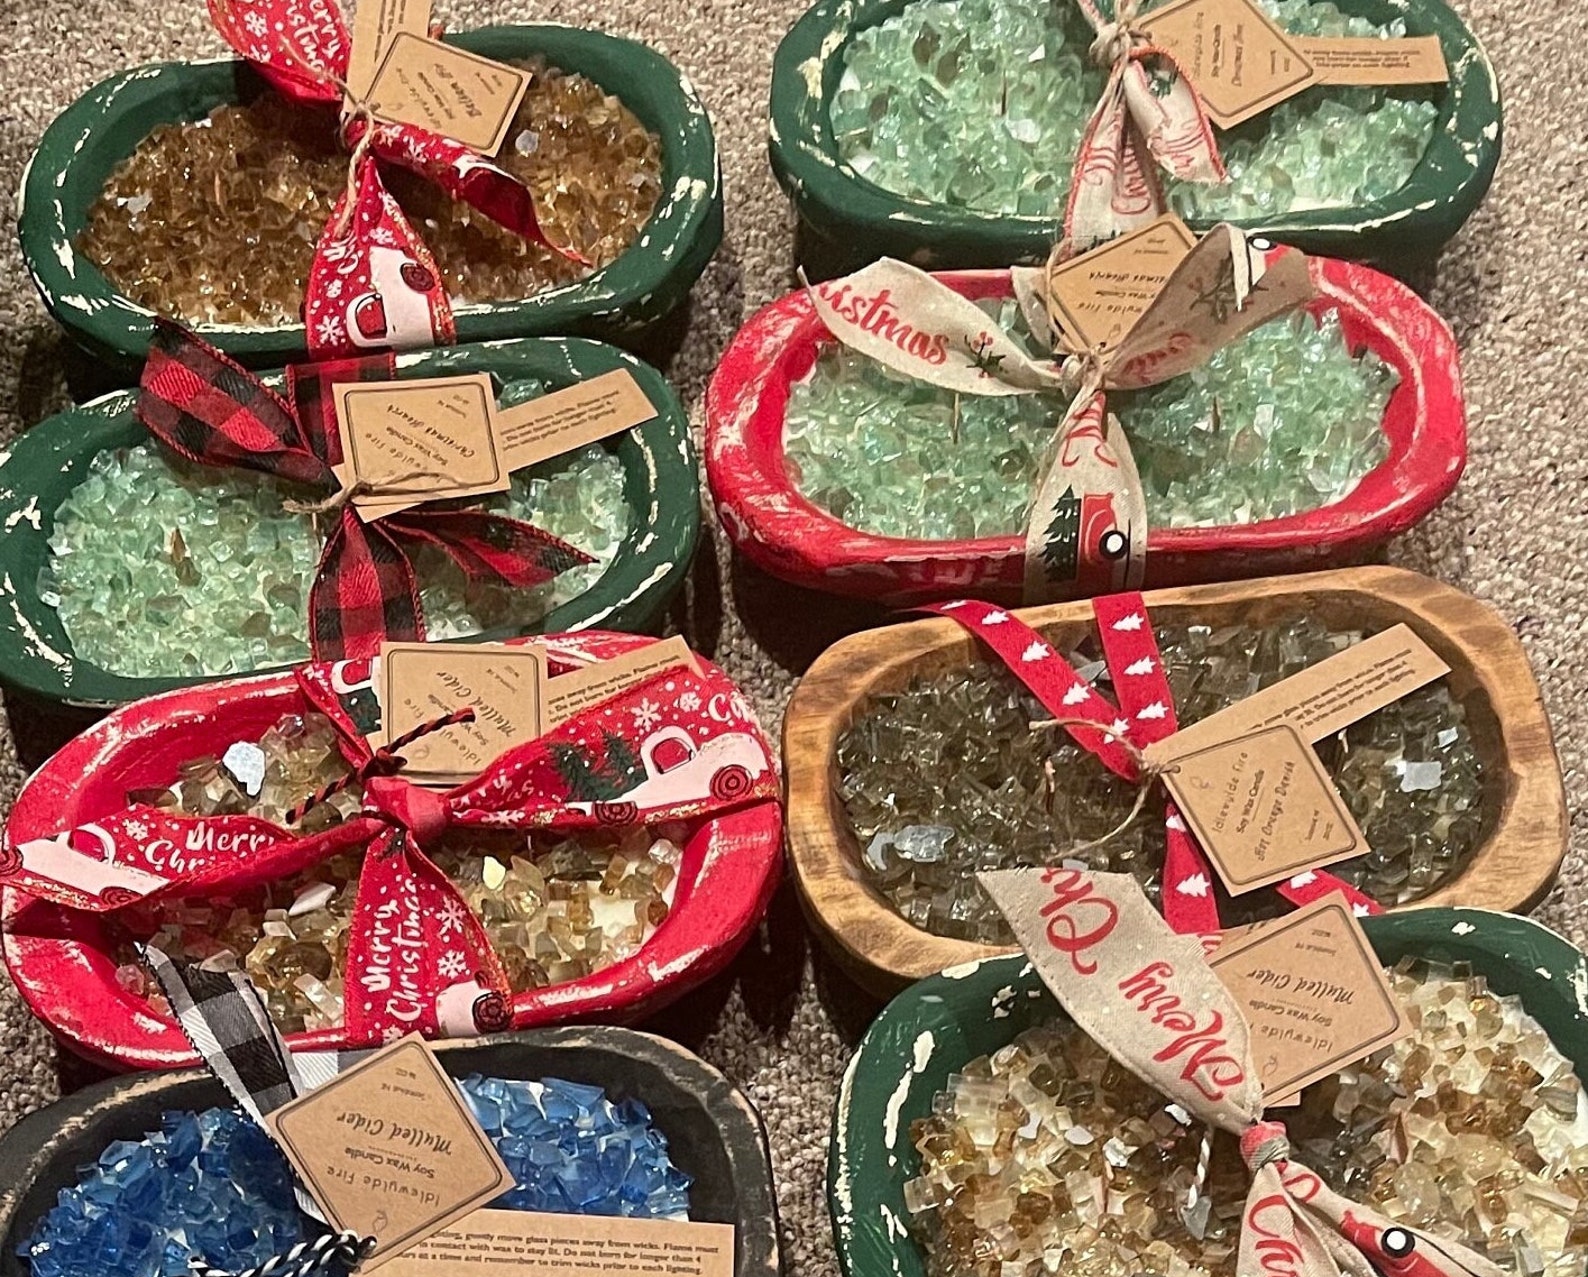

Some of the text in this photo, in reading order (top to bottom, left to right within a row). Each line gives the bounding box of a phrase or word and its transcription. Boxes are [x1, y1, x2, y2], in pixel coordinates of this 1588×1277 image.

[311, 0, 340, 58] erry
[435, 670, 471, 698] Cider
[468, 695, 516, 737] Mulled
[438, 728, 481, 765] Idlewyl
[185, 821, 275, 852] Merr
[361, 898, 399, 993] Merry
[1245, 968, 1354, 1005] Mulled Cider
[1118, 961, 1244, 1101] Merry
[1286, 1008, 1309, 1021] Wax
[1310, 1012, 1332, 1027] Soy
[1260, 1024, 1333, 1053] Idlewylde
[335, 1111, 452, 1156] Mulled Cider
[343, 1146, 435, 1179] Soy Wax Candle
[326, 1165, 440, 1207] Idlewylde Fire
